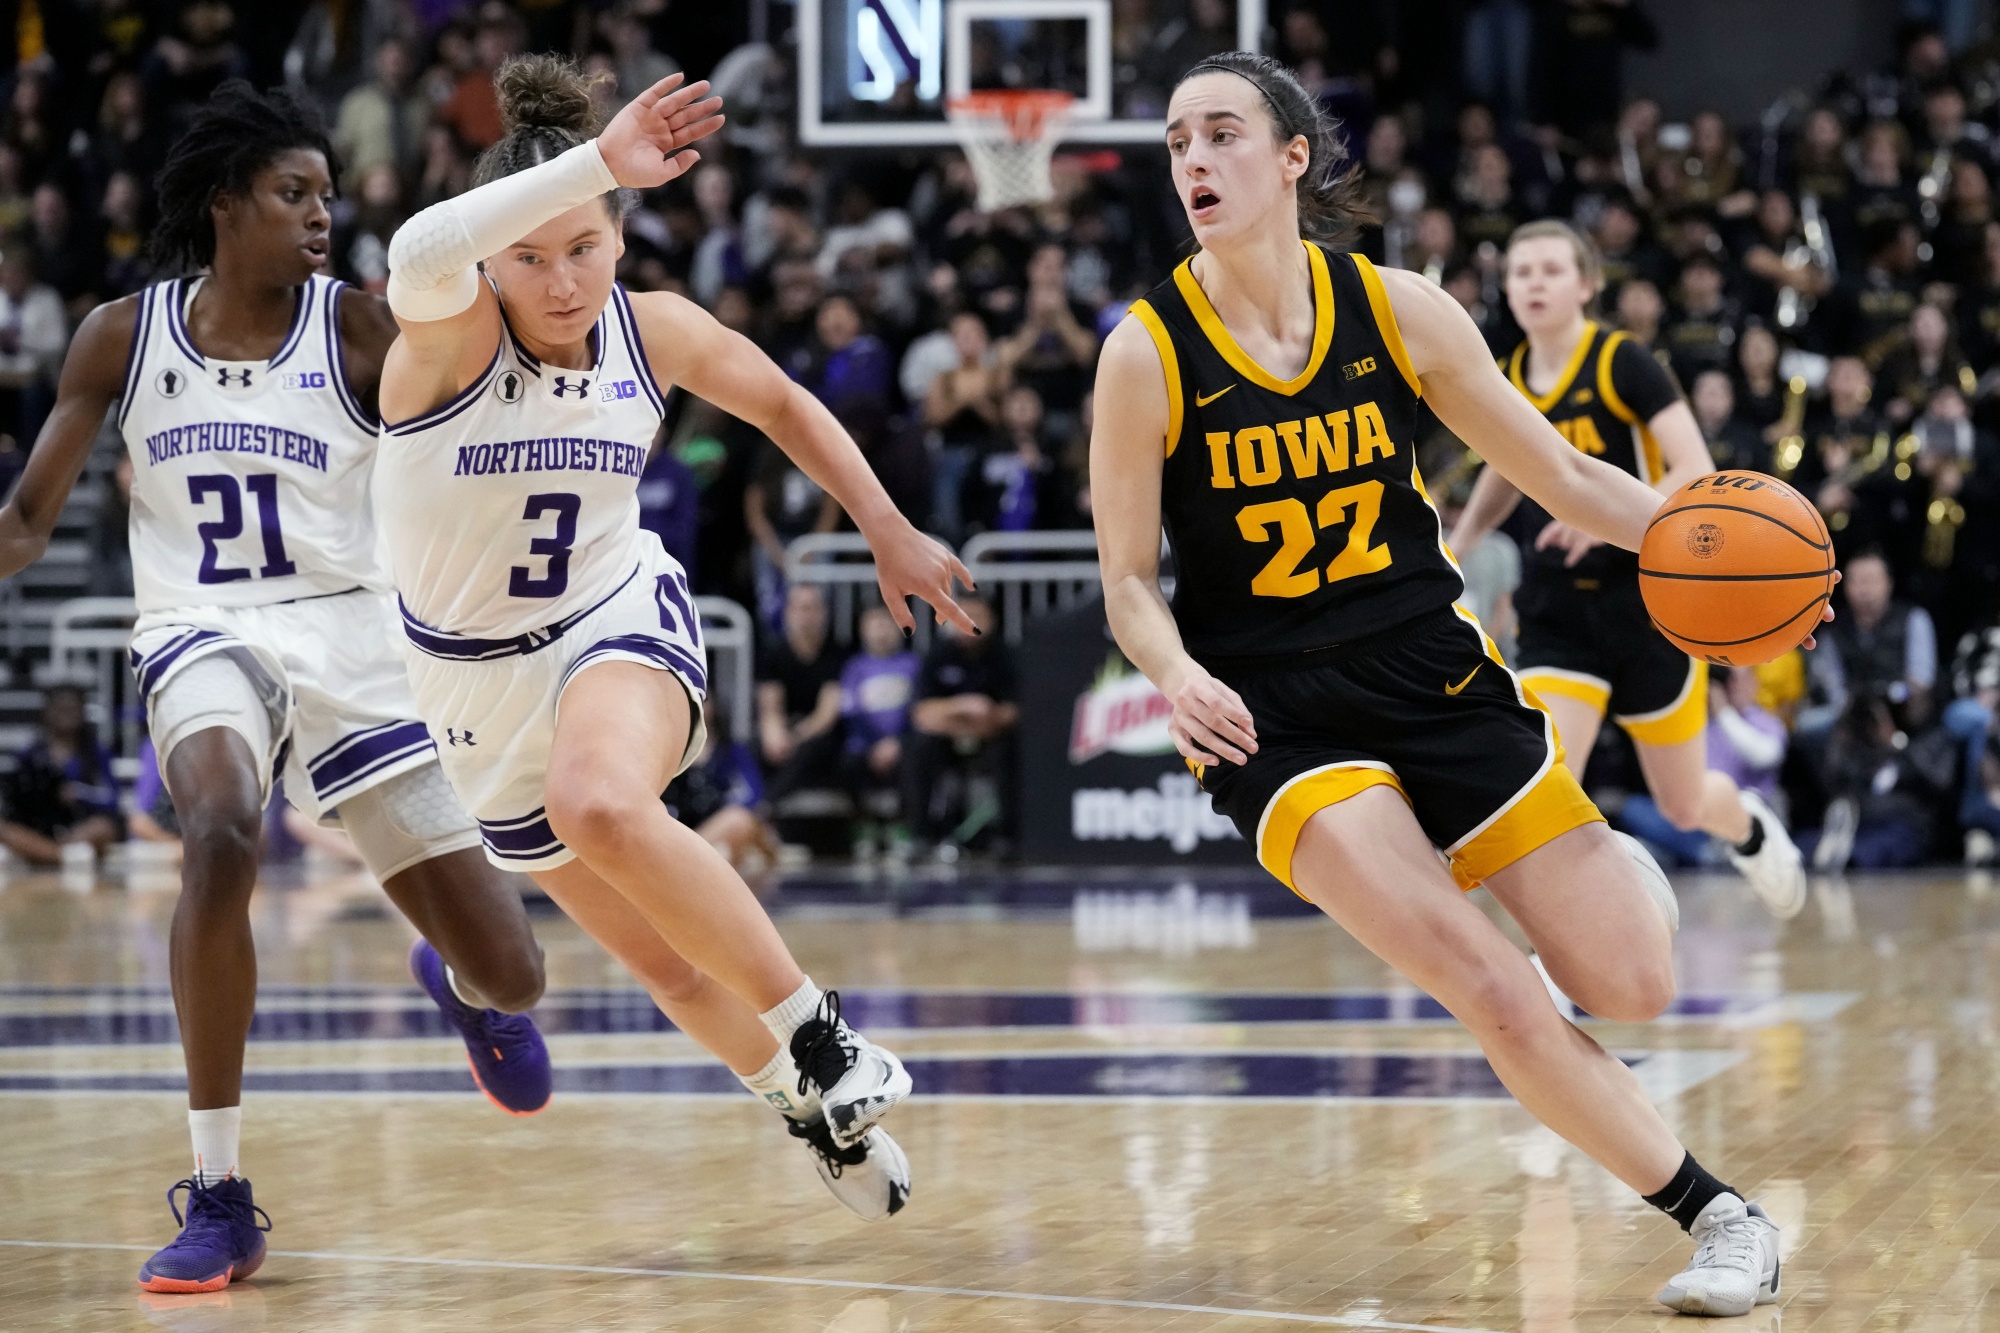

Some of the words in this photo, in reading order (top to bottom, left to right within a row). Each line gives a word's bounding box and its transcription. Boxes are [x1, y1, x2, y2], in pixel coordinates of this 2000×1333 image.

[146, 422, 329, 473] NORTHWESTERN
[454, 437, 646, 478] NORTHWESTERN
[1205, 401, 1396, 489] IOWA
[1687, 475, 1766, 491] EVO
[187, 473, 297, 584] 21
[508, 492, 581, 598] 3
[1235, 479, 1393, 598] 22
[1071, 772, 1246, 854] meije
